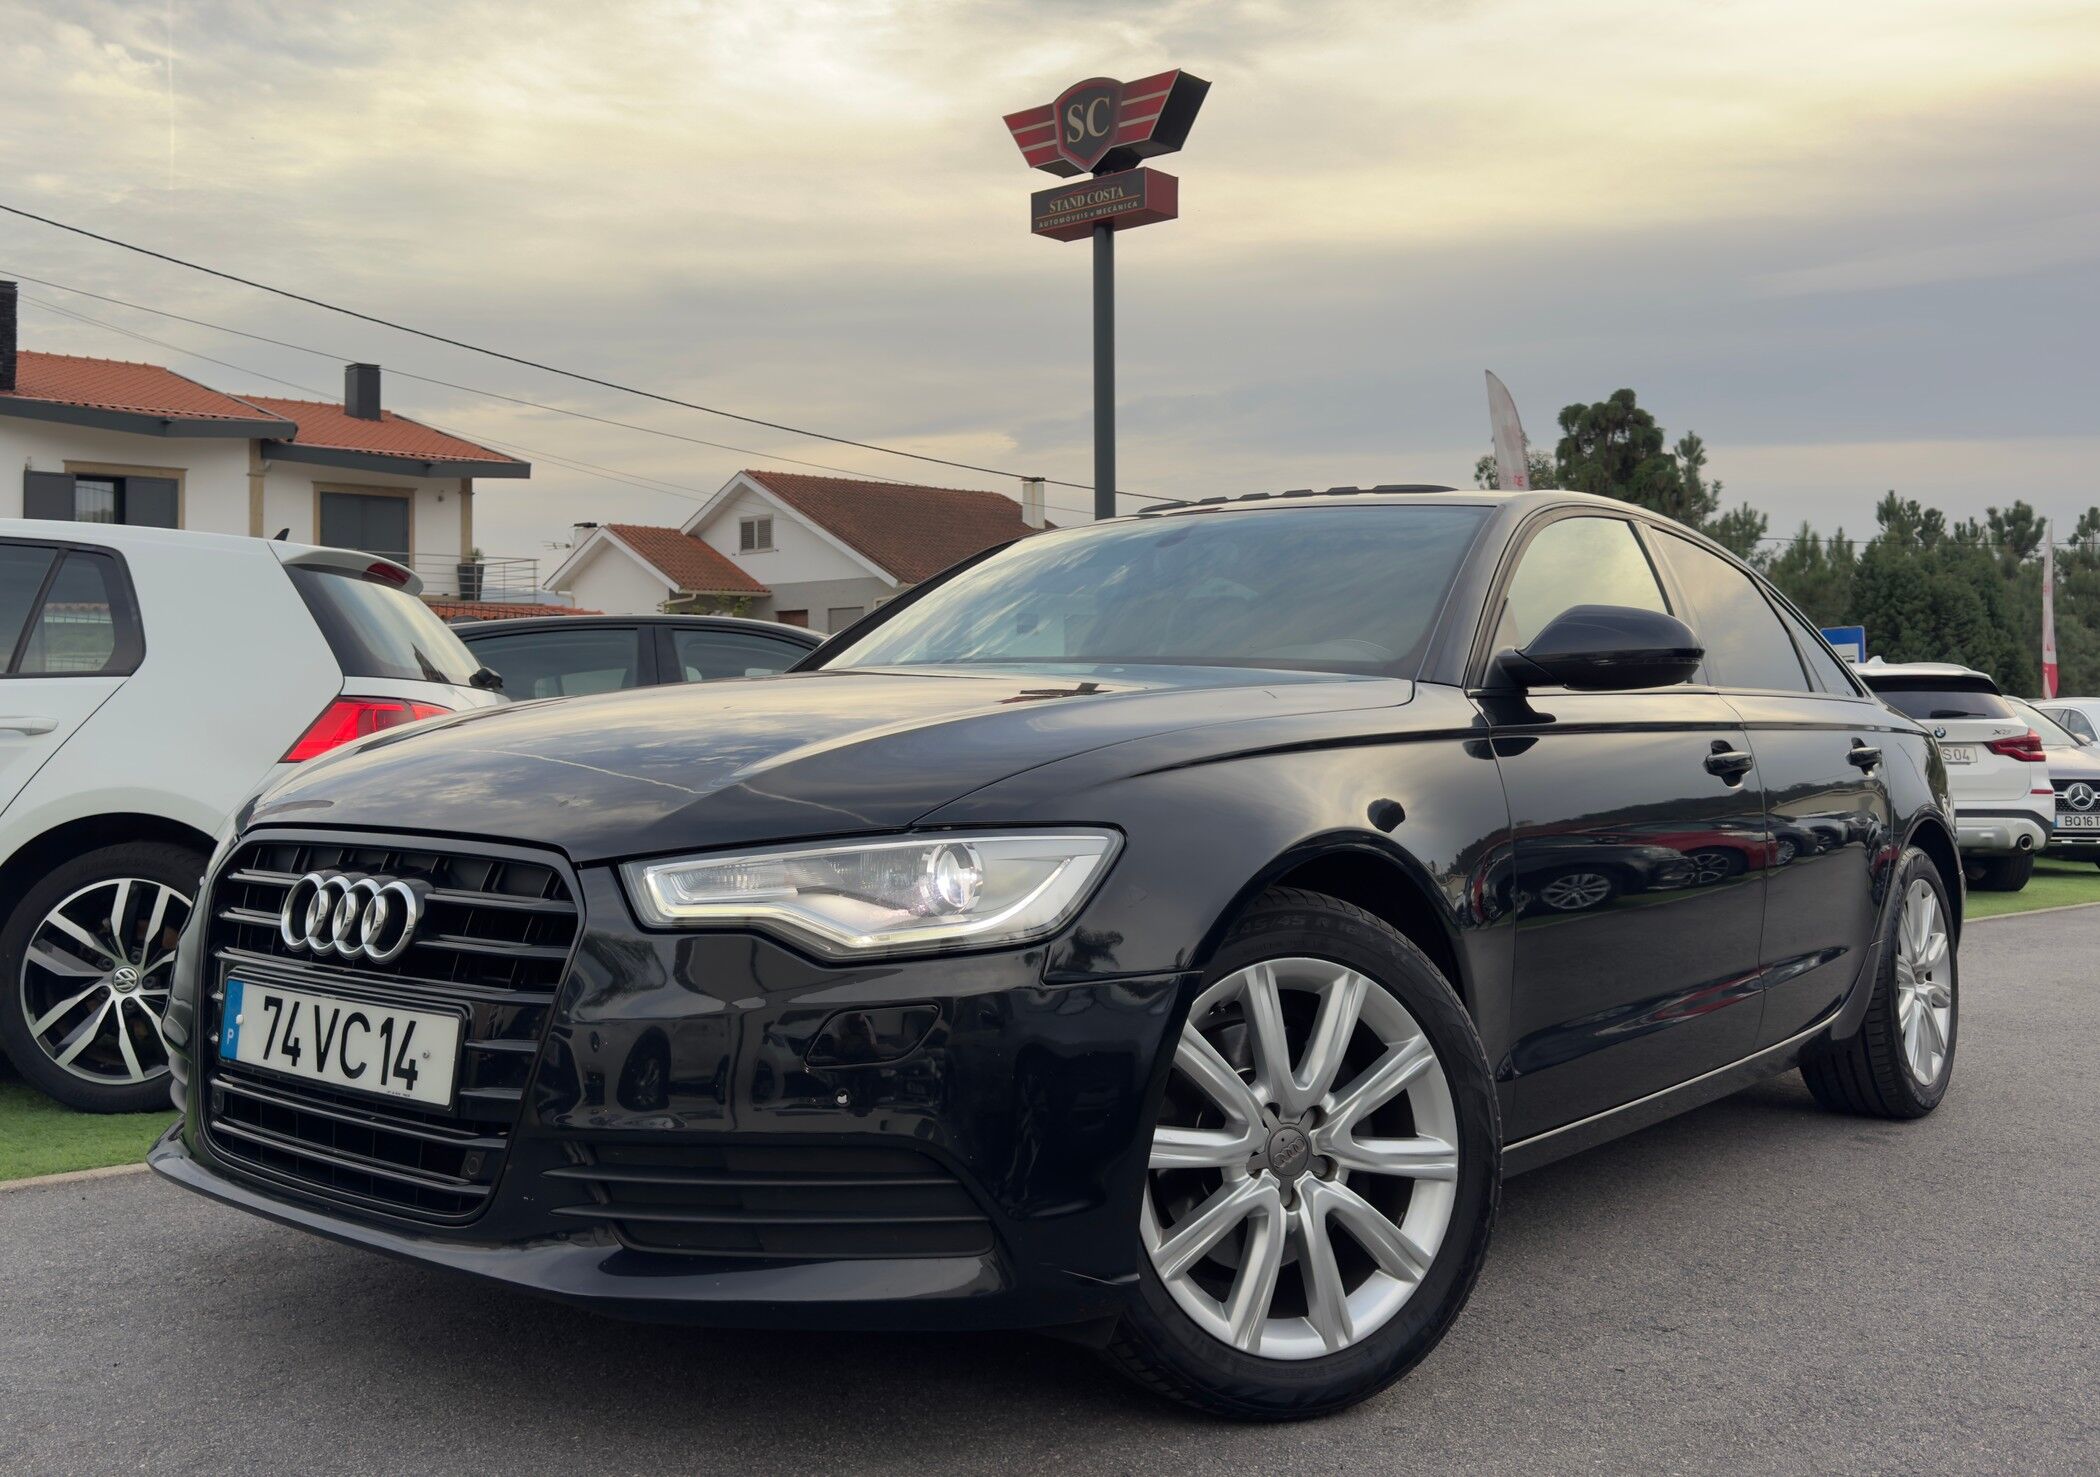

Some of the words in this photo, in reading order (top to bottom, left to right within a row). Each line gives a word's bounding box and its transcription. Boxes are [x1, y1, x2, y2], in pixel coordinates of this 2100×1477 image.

[1066, 96, 1110, 144] SC
[1049, 194, 1085, 213] STAND
[1087, 185, 1124, 204] COSTA
